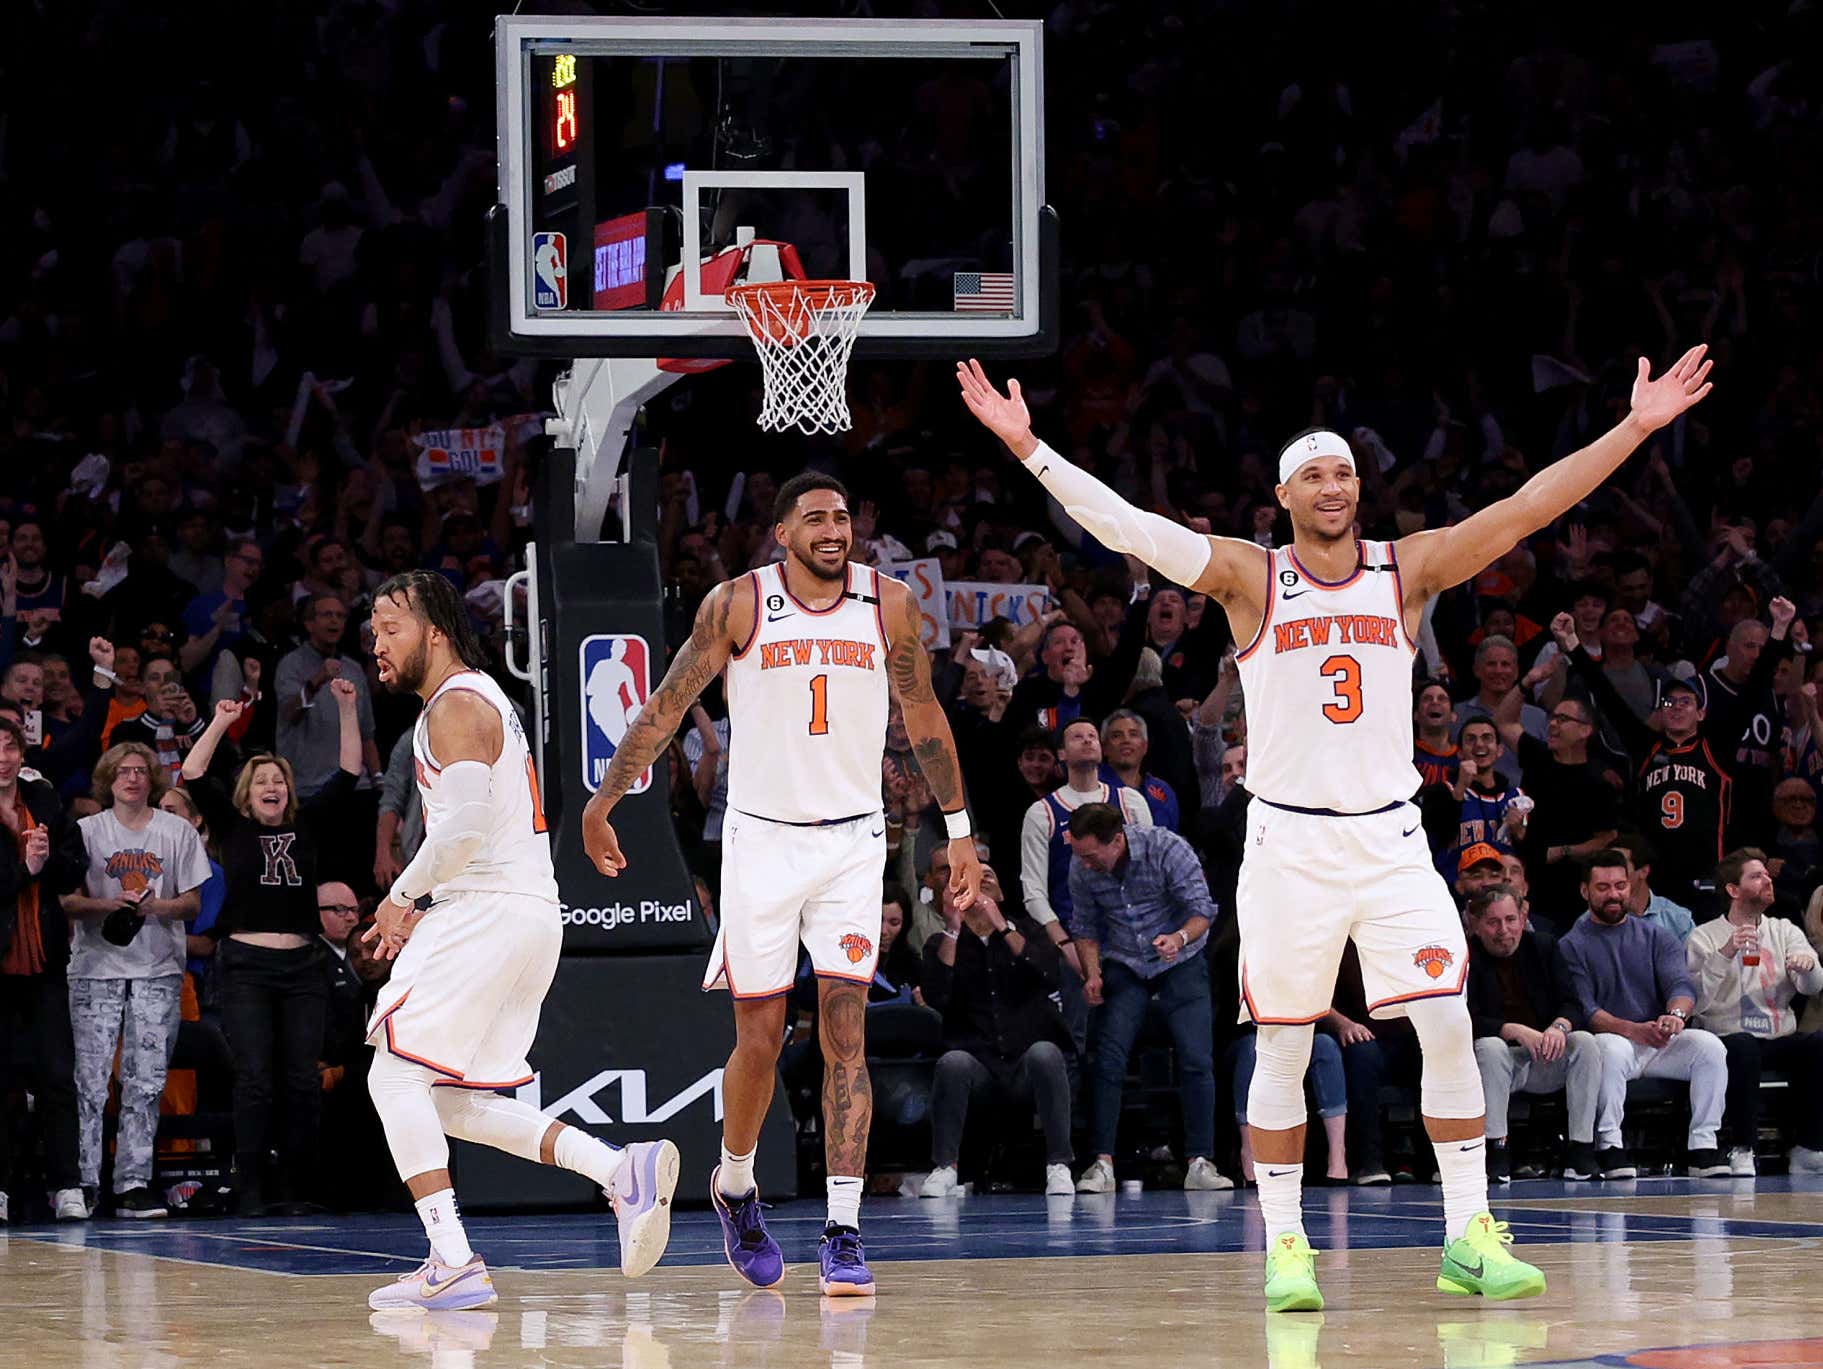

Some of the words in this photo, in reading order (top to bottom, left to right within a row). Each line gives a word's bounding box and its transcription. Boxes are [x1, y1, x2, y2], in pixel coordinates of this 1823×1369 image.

[556, 91, 576, 148] 24
[537, 291, 555, 305] NBA
[1282, 571, 1296, 586] 6
[769, 596, 782, 610] 6
[1273, 615, 1333, 655] NEW
[1334, 614, 1398, 649] YORK
[760, 639, 814, 671] NEW
[815, 639, 876, 671] YORK
[808, 673, 829, 736] 1
[1319, 654, 1364, 725] 3
[1646, 764, 1671, 792] NEW
[1672, 763, 1707, 790] YORK
[1661, 790, 1685, 830] 9
[106, 851, 162, 875] KNICKS
[257, 832, 303, 887] K
[561, 902, 635, 930] Google
[640, 900, 692, 923] Pixel
[1744, 1016, 1769, 1030] NBA
